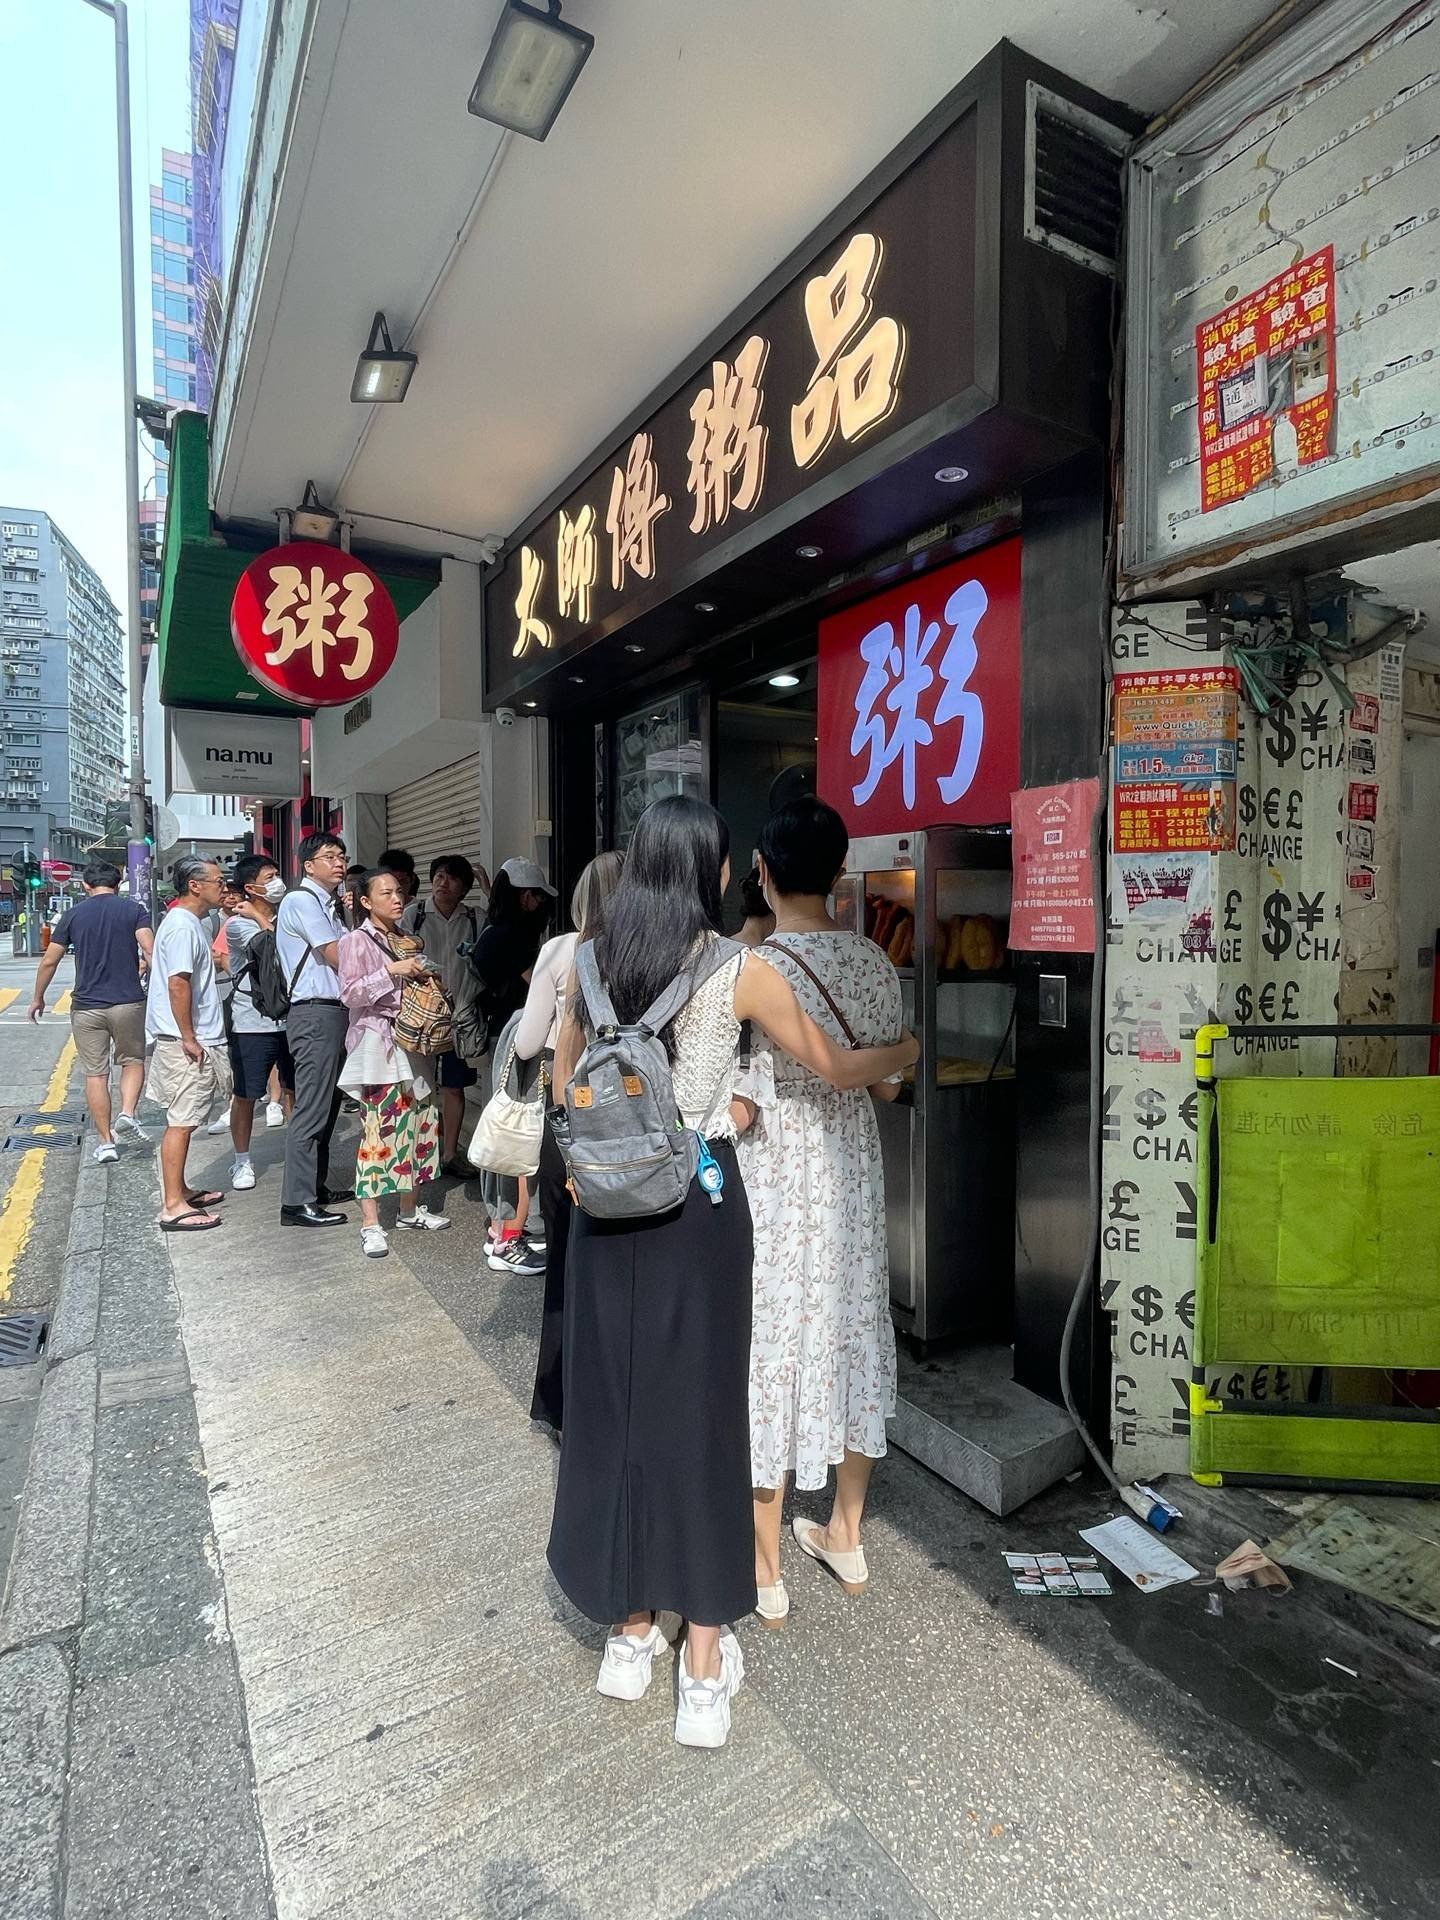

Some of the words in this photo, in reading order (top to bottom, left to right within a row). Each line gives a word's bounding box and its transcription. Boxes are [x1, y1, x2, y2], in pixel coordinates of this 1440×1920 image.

[1204, 270, 1326, 350] 消防安全指示
[1204, 343, 1257, 383] 防火門
[1270, 303, 1327, 348] 防火窗
[1204, 326, 1256, 368] 驗樓
[262, 565, 374, 681] 粥
[1111, 633, 1149, 659] GE
[850, 579, 989, 811] 粥
[205, 747, 273, 766] na.mu
[1237, 832, 1303, 860] CHANGE
[1103, 1226, 1140, 1253] GE
